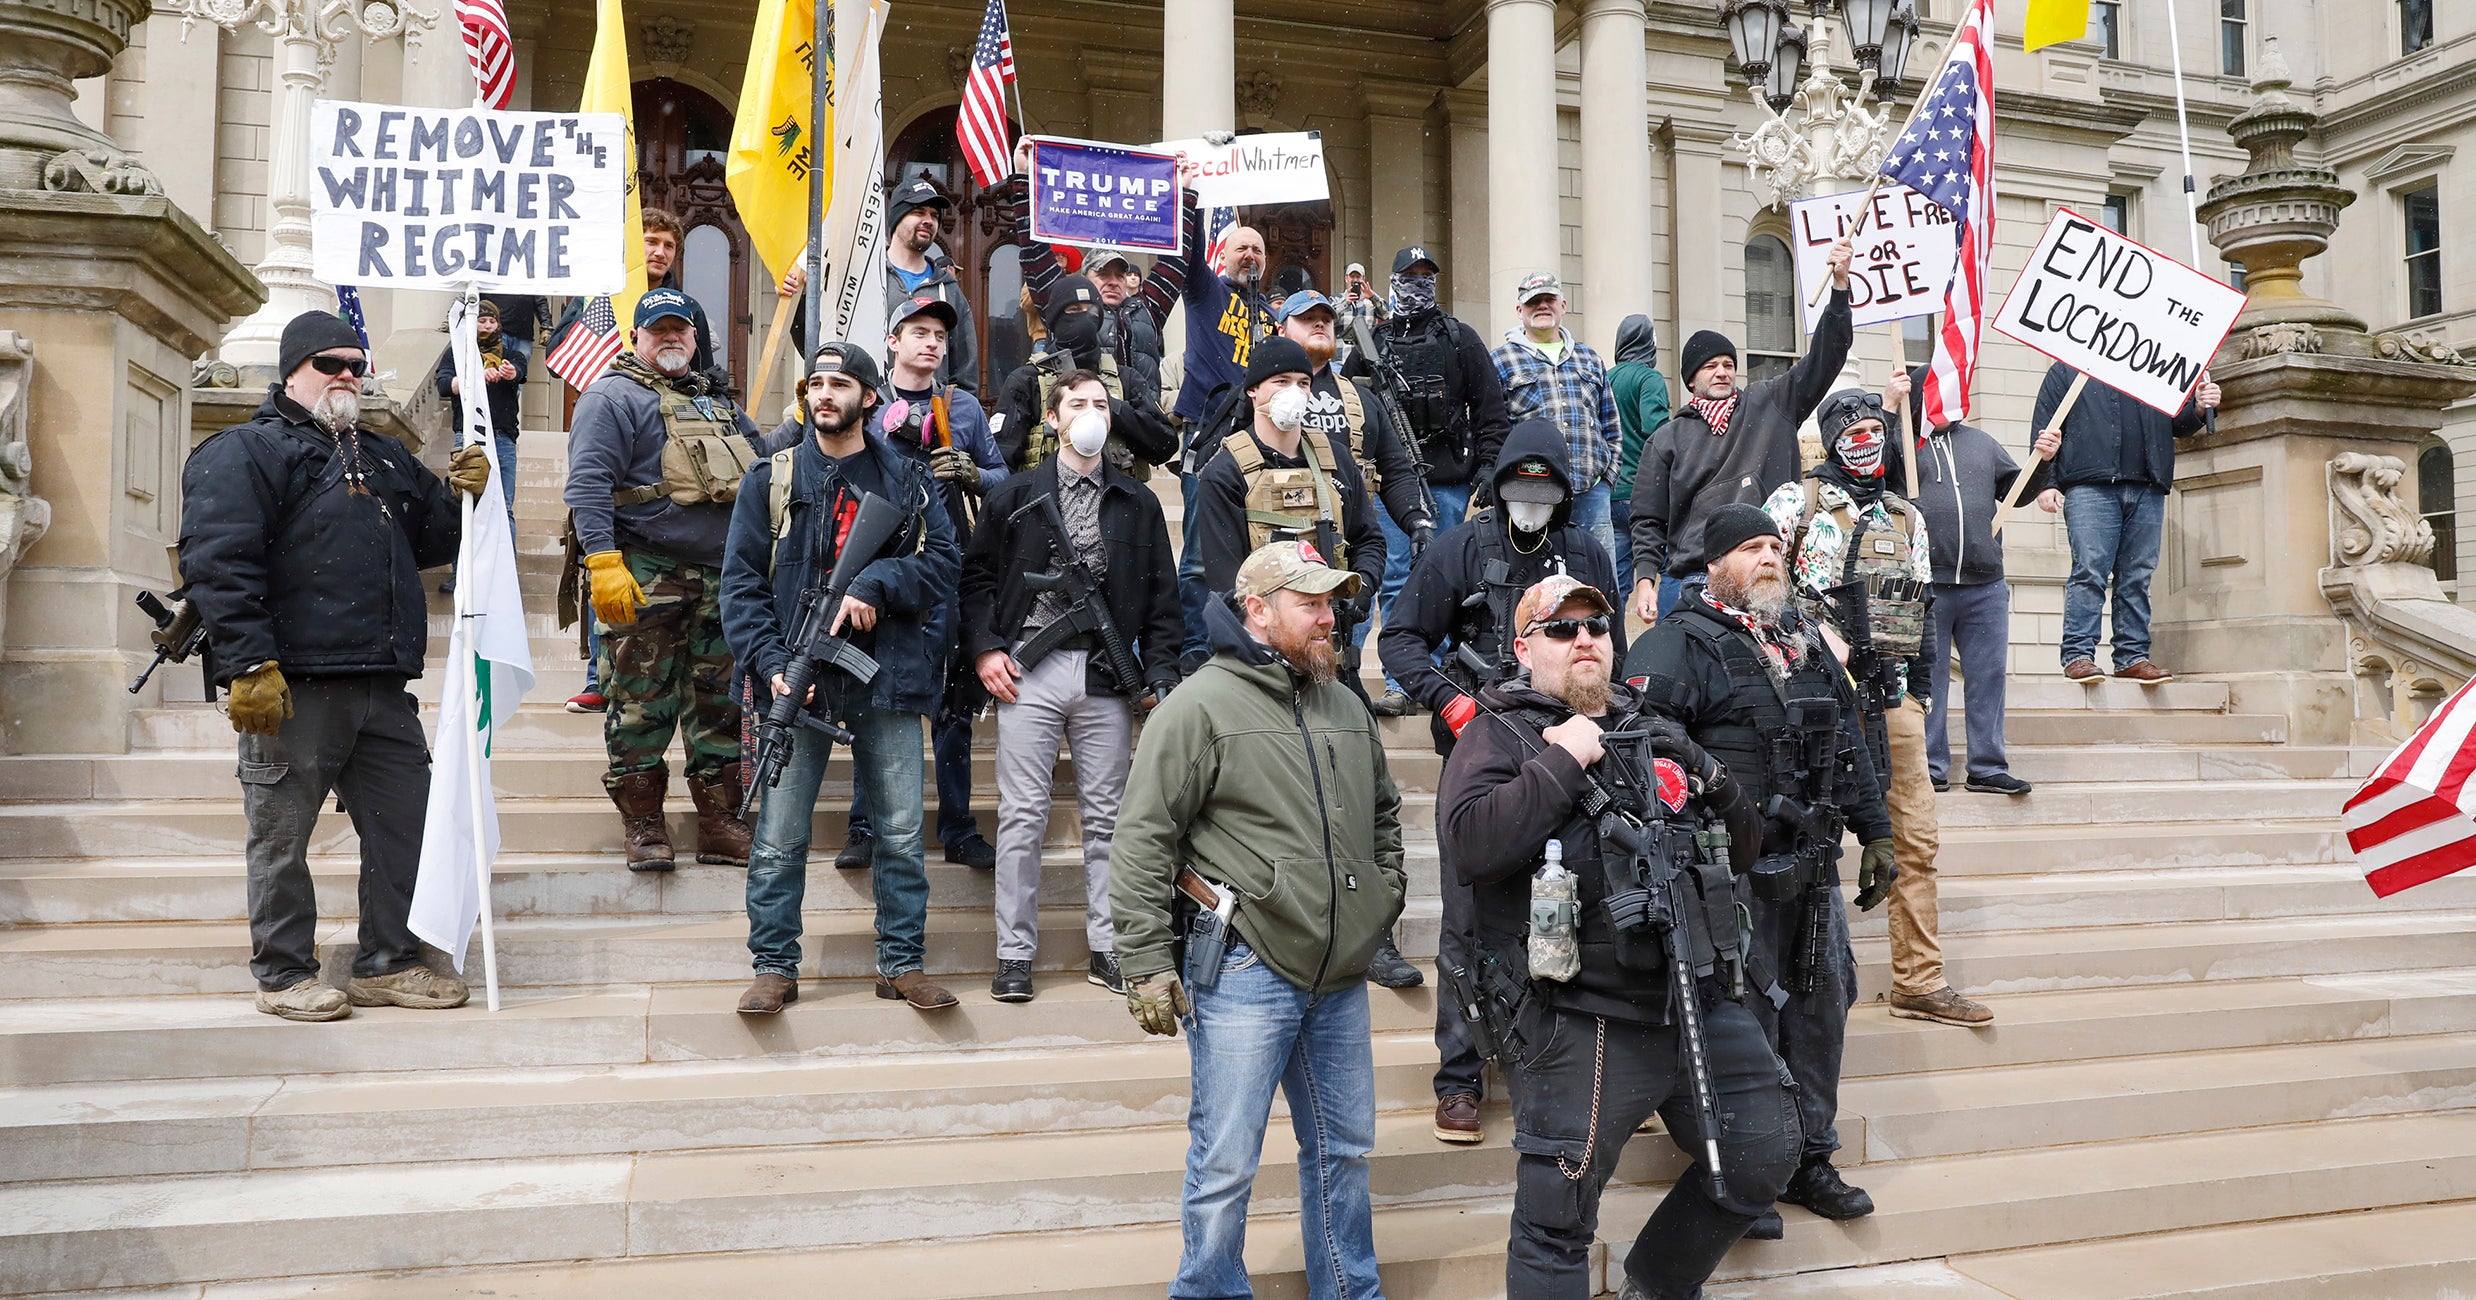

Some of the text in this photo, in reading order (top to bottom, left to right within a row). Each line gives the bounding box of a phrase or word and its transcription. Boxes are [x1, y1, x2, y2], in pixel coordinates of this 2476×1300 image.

[332, 108, 607, 169] REMOVE THE
[1041, 167, 1171, 197] TRUMP
[1189, 146, 1321, 180] ecall Whitmer
[317, 166, 581, 219] WHITMER
[1049, 206, 1070, 214] MAKE
[1072, 209, 1106, 218] AMERICA
[1108, 212, 1132, 220] GREAT
[1053, 191, 1158, 212] PENCE
[358, 221, 571, 278] REGIME
[1095, 237, 1117, 245] 2016
[2043, 219, 2153, 299] END
[1848, 261, 1930, 309] DIE
[2167, 297, 2204, 326] THE
[2019, 278, 2201, 393] LOCKDOWN
